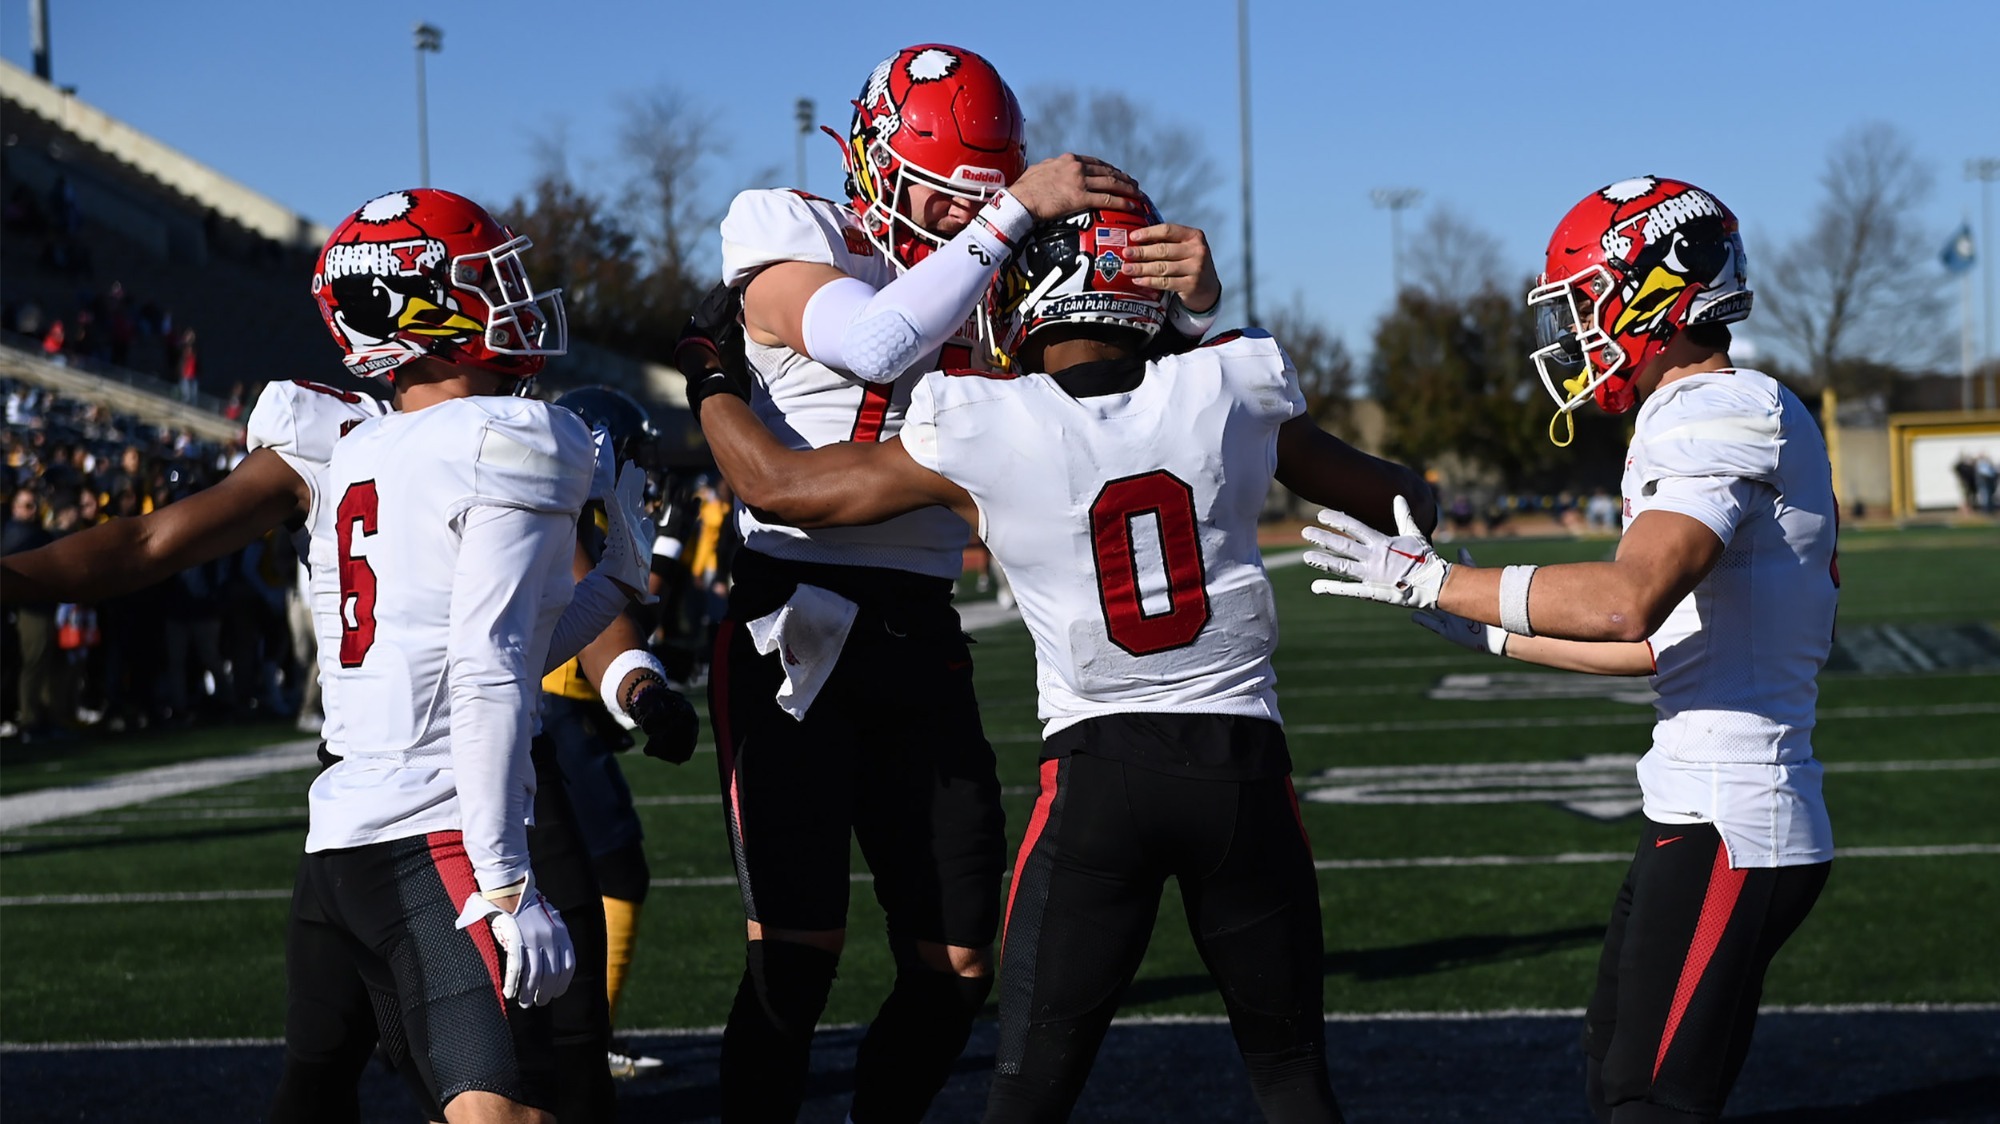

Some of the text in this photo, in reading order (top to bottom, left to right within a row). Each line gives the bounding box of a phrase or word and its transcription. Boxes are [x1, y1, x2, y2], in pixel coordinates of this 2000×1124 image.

[962, 168, 1003, 184] Riddell
[391, 244, 427, 271] Y
[1056, 302, 1063, 313] I
[1063, 301, 1085, 312] CAN
[1084, 300, 1109, 311] PLAY
[1110, 301, 1147, 315] BECAUSE
[364, 356, 399, 371] SERVED
[335, 478, 379, 669] 6
[1088, 468, 1211, 658] 0
